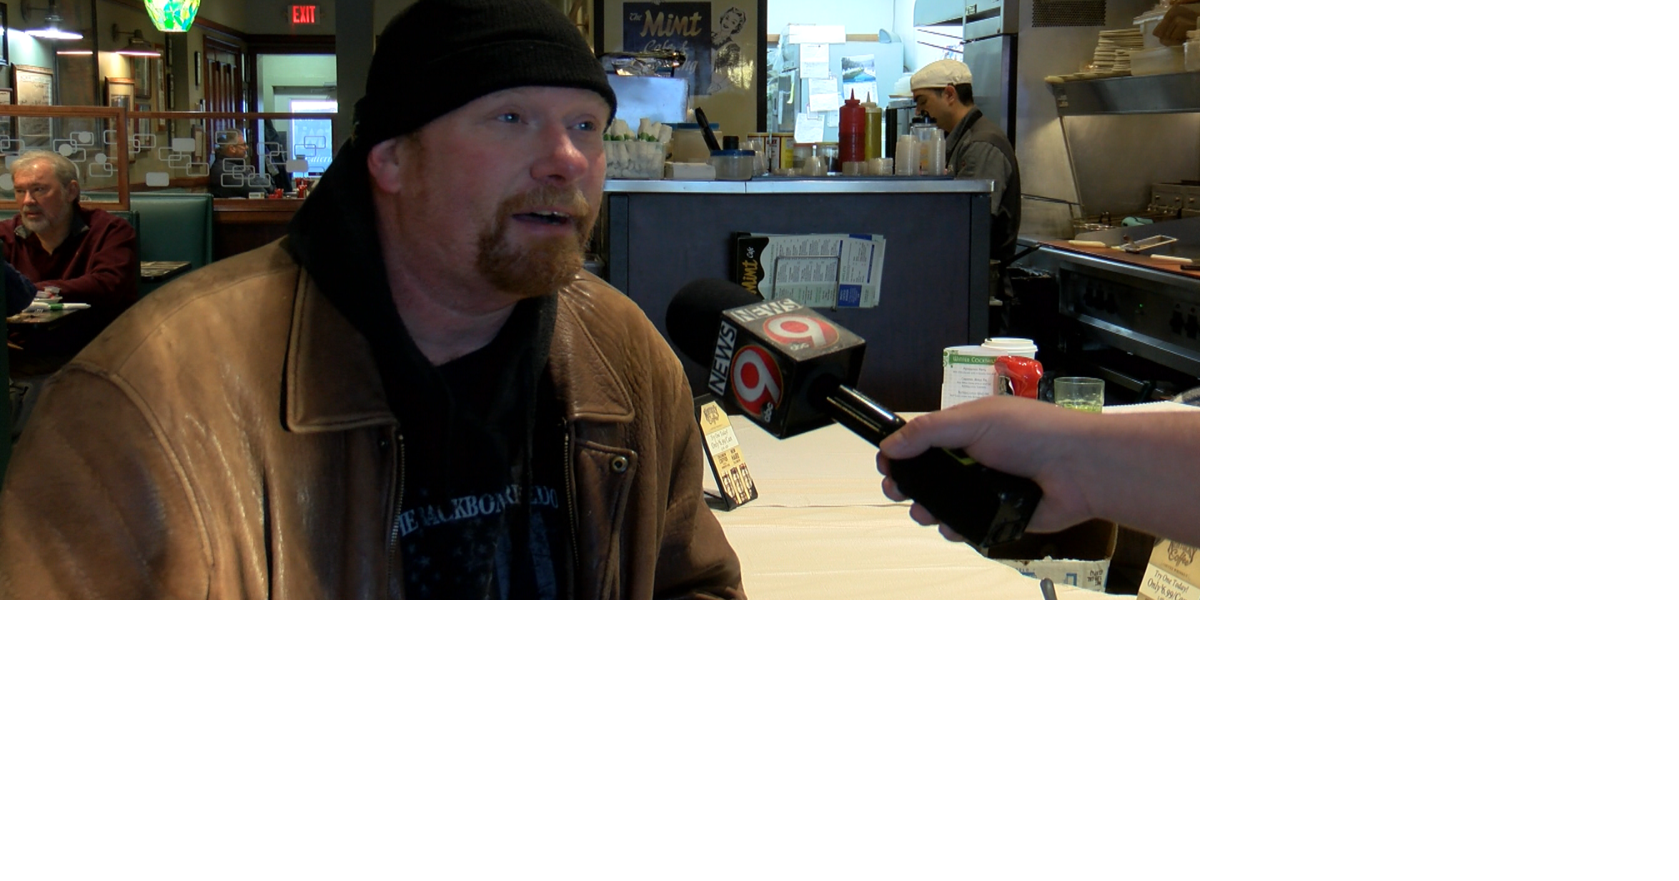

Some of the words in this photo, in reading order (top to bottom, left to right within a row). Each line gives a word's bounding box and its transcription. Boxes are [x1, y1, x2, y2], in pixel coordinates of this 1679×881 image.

[292, 5, 316, 24] EXIT
[640, 9, 702, 37] Mint
[741, 259, 759, 295] Mint
[731, 299, 802, 322] NEWS
[768, 316, 826, 347] 9
[709, 321, 737, 396] NEWS
[733, 349, 780, 403] 9
[763, 401, 774, 423] abc
